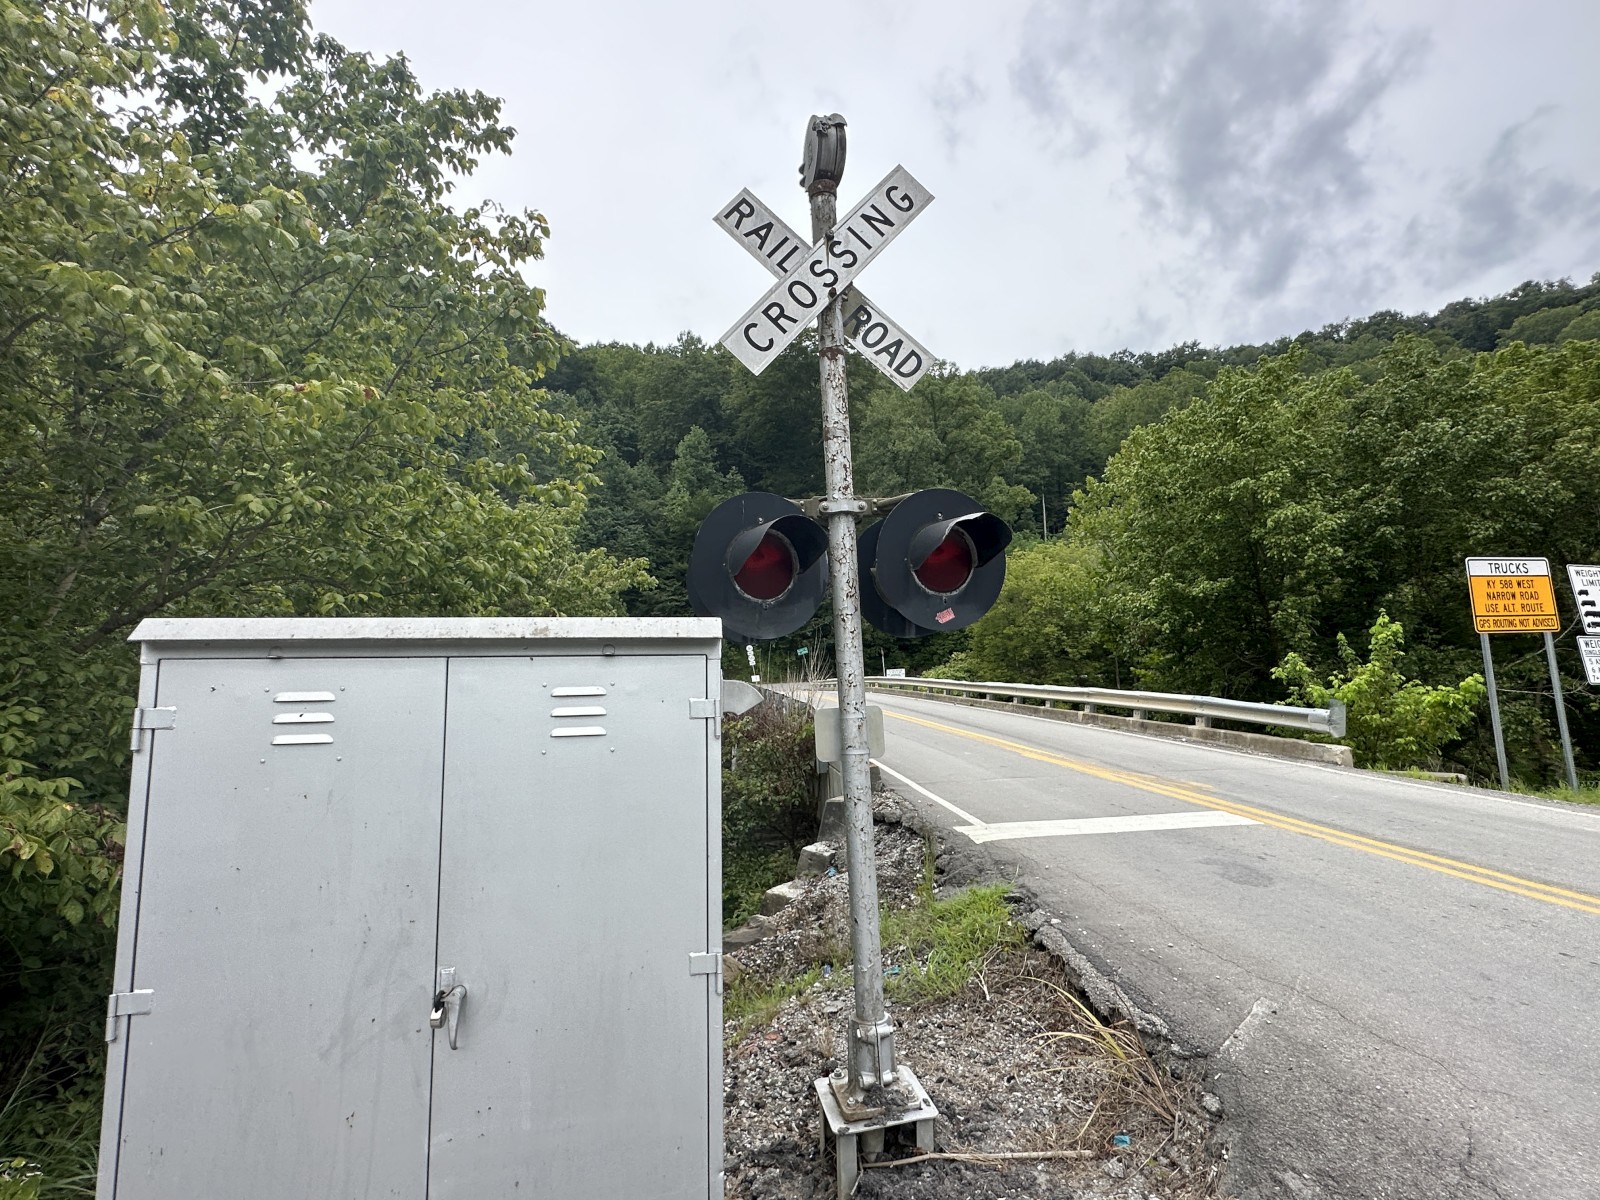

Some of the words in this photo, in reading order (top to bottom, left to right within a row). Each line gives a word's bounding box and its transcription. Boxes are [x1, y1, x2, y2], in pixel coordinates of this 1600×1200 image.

[723, 197, 800, 274] RAIL
[743, 185, 914, 352] CROSSING
[843, 304, 923, 378] ROAD
[1488, 562, 1529, 574] TRUCKS
[1486, 580, 1496, 589] KY
[1500, 580, 1513, 588] 588
[1516, 579, 1535, 588] WEST
[1486, 591, 1516, 601] NARROW
[1520, 591, 1539, 600] ROAD
[1485, 603, 1500, 613] USE
[1503, 603, 1518, 612] ALT.
[1521, 603, 1545, 612] ROUTE
[1479, 619, 1491, 628] GPS
[1492, 618, 1517, 628] ROUTING
[1519, 618, 1530, 627] NOT
[1532, 618, 1556, 627] ADVISED
